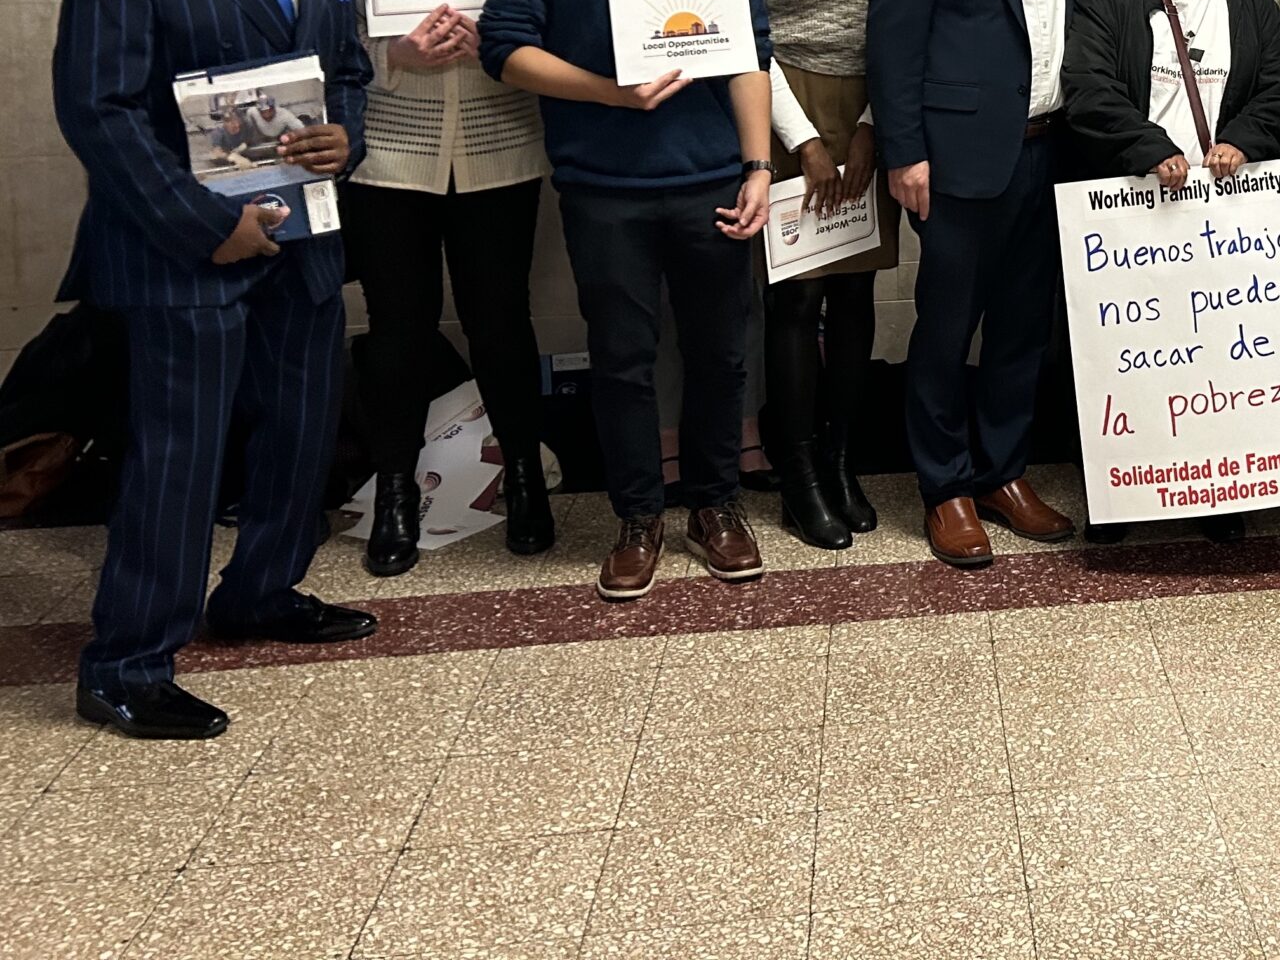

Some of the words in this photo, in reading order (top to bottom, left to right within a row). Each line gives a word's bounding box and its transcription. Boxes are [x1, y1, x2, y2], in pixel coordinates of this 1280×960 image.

[643, 41, 666, 50] Local
[668, 37, 729, 48] Opportunities
[667, 48, 707, 57] Coalition
[1151, 66, 1176, 78] orking
[1089, 187, 1155, 210] Working
[1160, 180, 1210, 203] Family
[816, 213, 867, 235] Pro-Worker
[1085, 233, 1194, 272] Buenos
[1099, 297, 1160, 326] nos
[1118, 344, 1203, 373] sacar
[1230, 324, 1275, 360] de
[1102, 394, 1135, 435] la
[1110, 459, 1212, 487] Solidaridad
[1218, 457, 1240, 477] de
[1157, 479, 1279, 508] Trabajadoras
